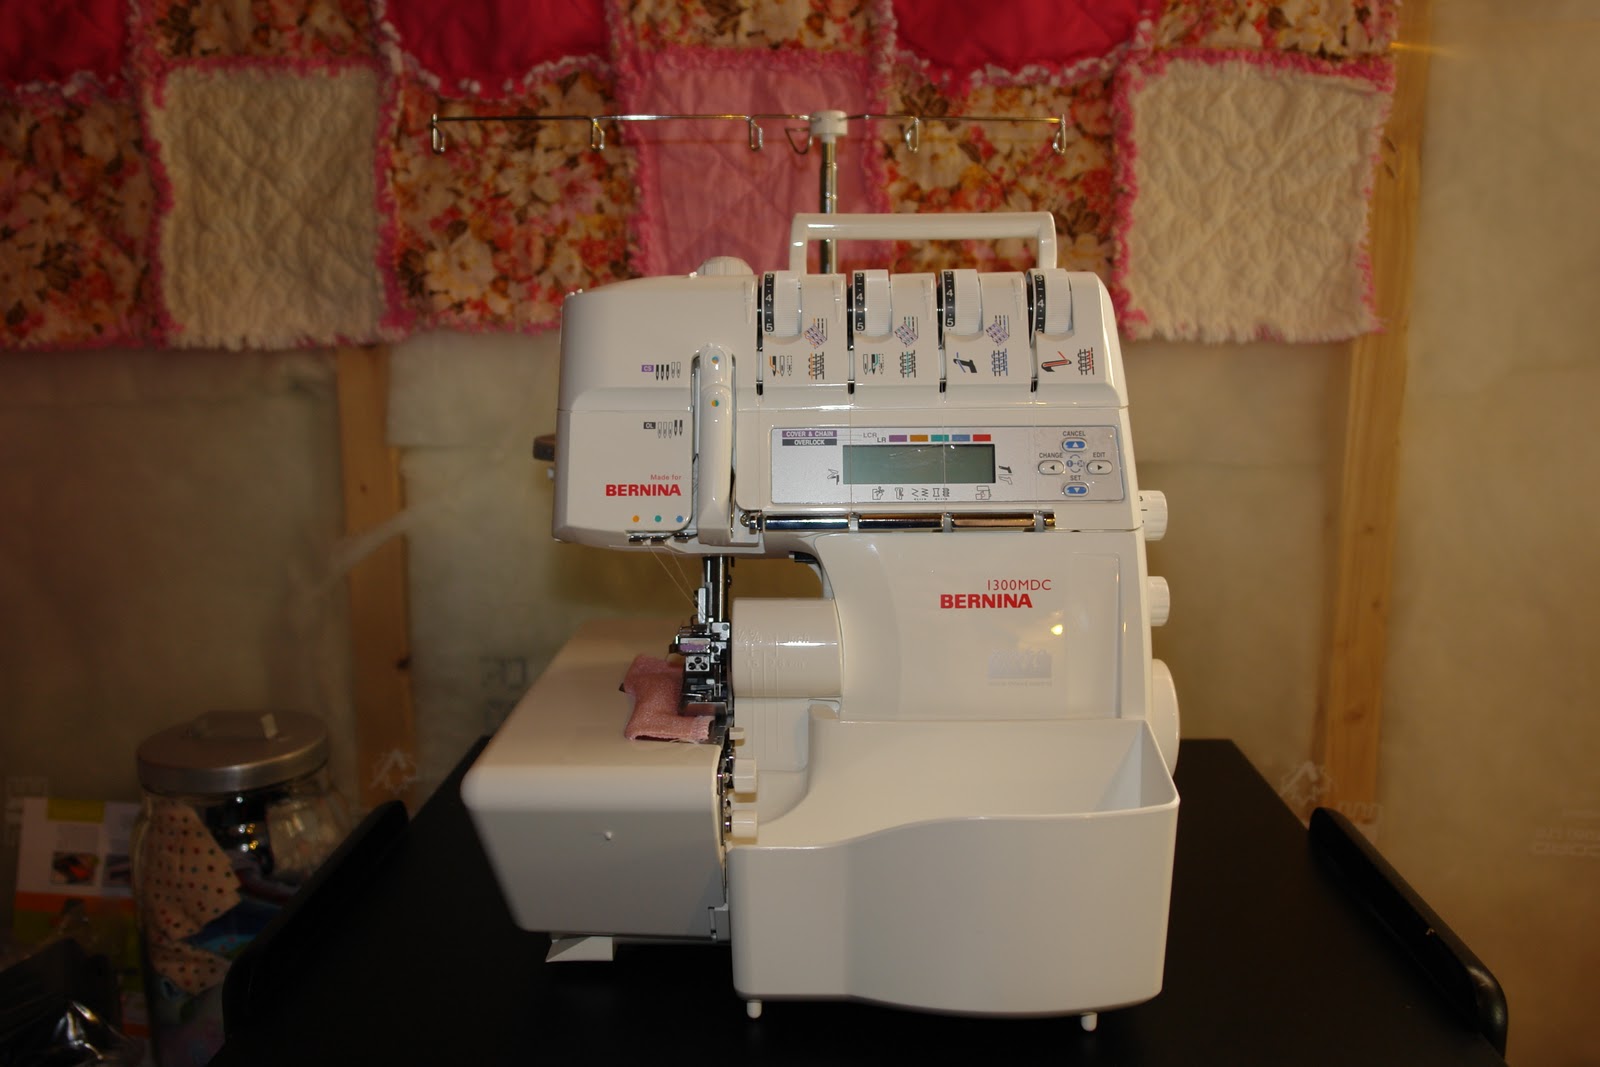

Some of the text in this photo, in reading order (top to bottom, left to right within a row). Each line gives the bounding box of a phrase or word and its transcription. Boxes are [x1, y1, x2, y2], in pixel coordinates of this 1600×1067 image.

[856, 292, 864, 301] 4
[946, 289, 954, 297] 4
[765, 294, 772, 302] 4
[1037, 299, 1044, 308] 4
[856, 322, 864, 330] 5
[946, 318, 954, 326] 5
[766, 323, 773, 332] 5
[605, 484, 682, 497] BERNINA
[987, 579, 1052, 591] 1300MDC
[940, 593, 1033, 609] BERNINA
